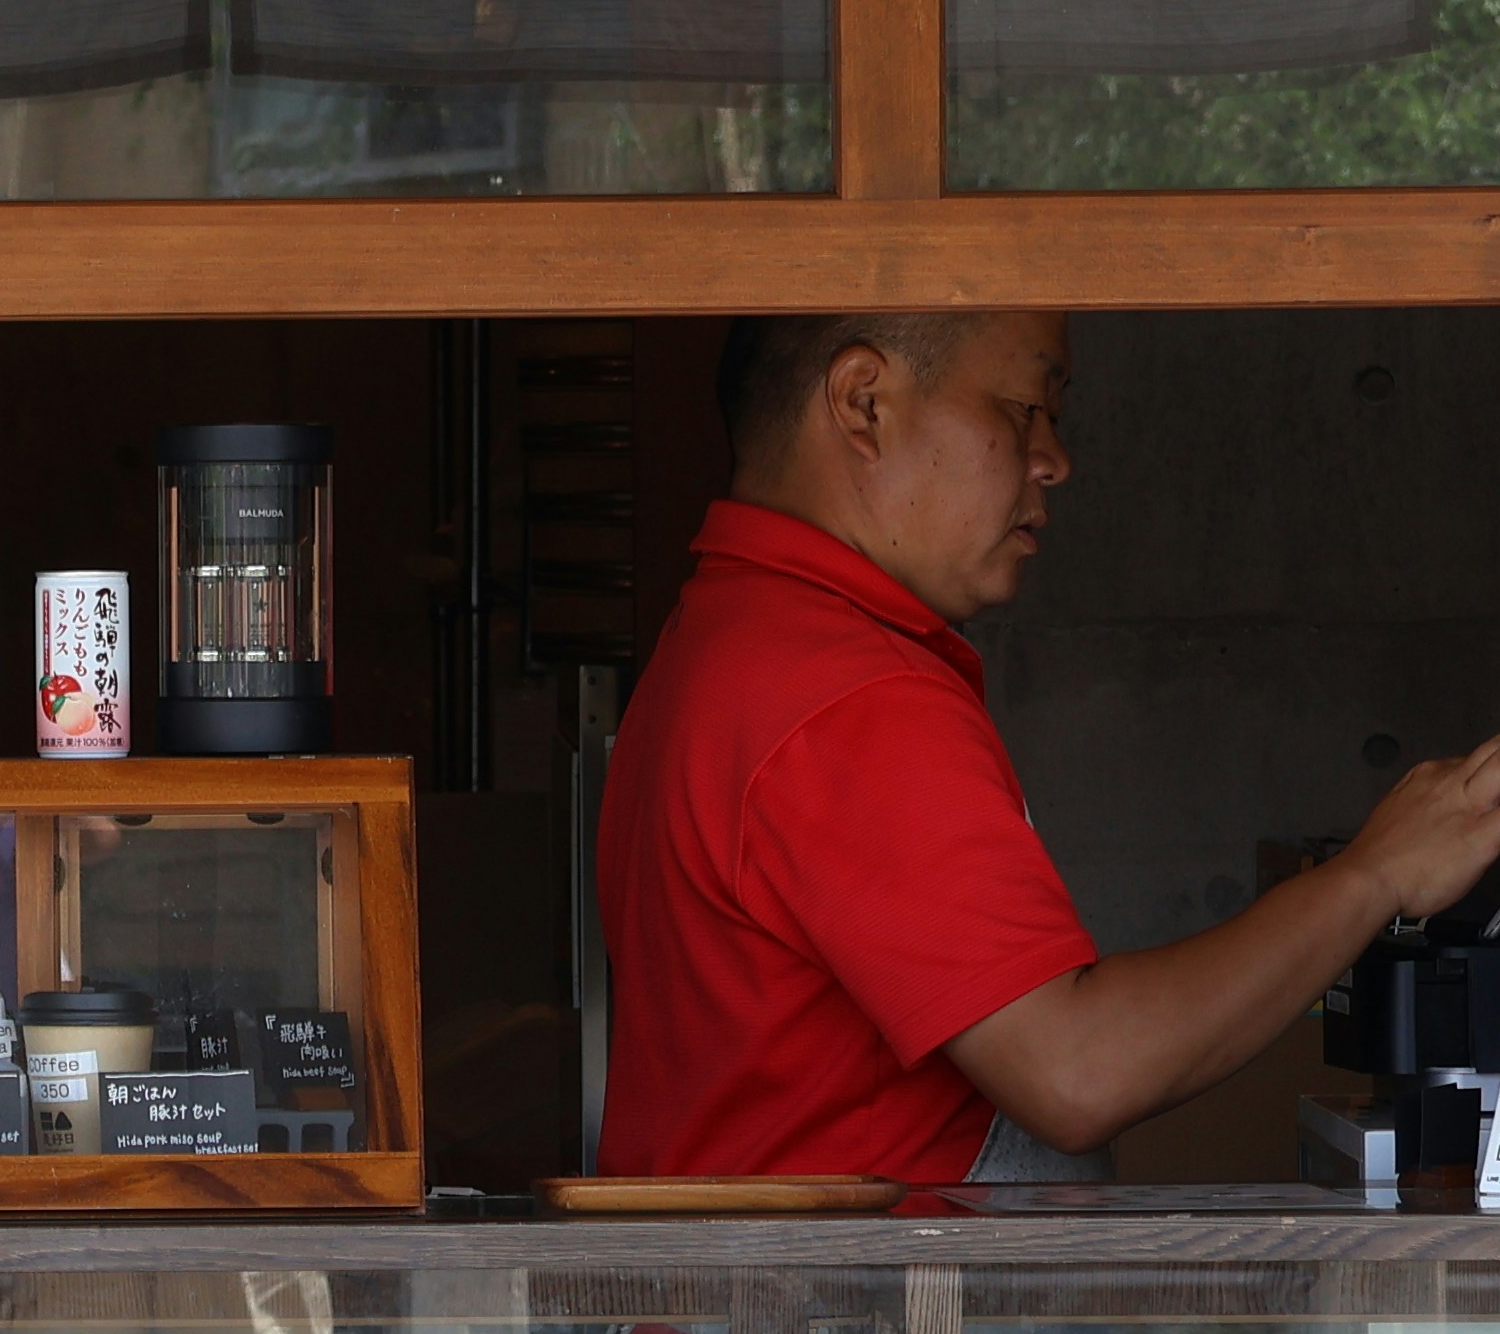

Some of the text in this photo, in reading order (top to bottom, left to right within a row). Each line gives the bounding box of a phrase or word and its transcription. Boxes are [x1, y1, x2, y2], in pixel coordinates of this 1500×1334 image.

[239, 508, 284, 518] BALMUDA
[55, 589, 69, 657] ミックス
[72, 587, 89, 678] りんごもも
[93, 587, 121, 735] 飛騨の朝露
[200, 1036, 228, 1059] 豚汁
[40, 1083, 70, 1099] 350
[107, 1083, 177, 1105] 朝ごはん
[149, 1103, 226, 1122] 豚汁セット
[1, 1131, 20, 1143] set
[117, 1134, 143, 1148] Hida
[144, 1134, 168, 1148] pork
[170, 1133, 194, 1146] miso
